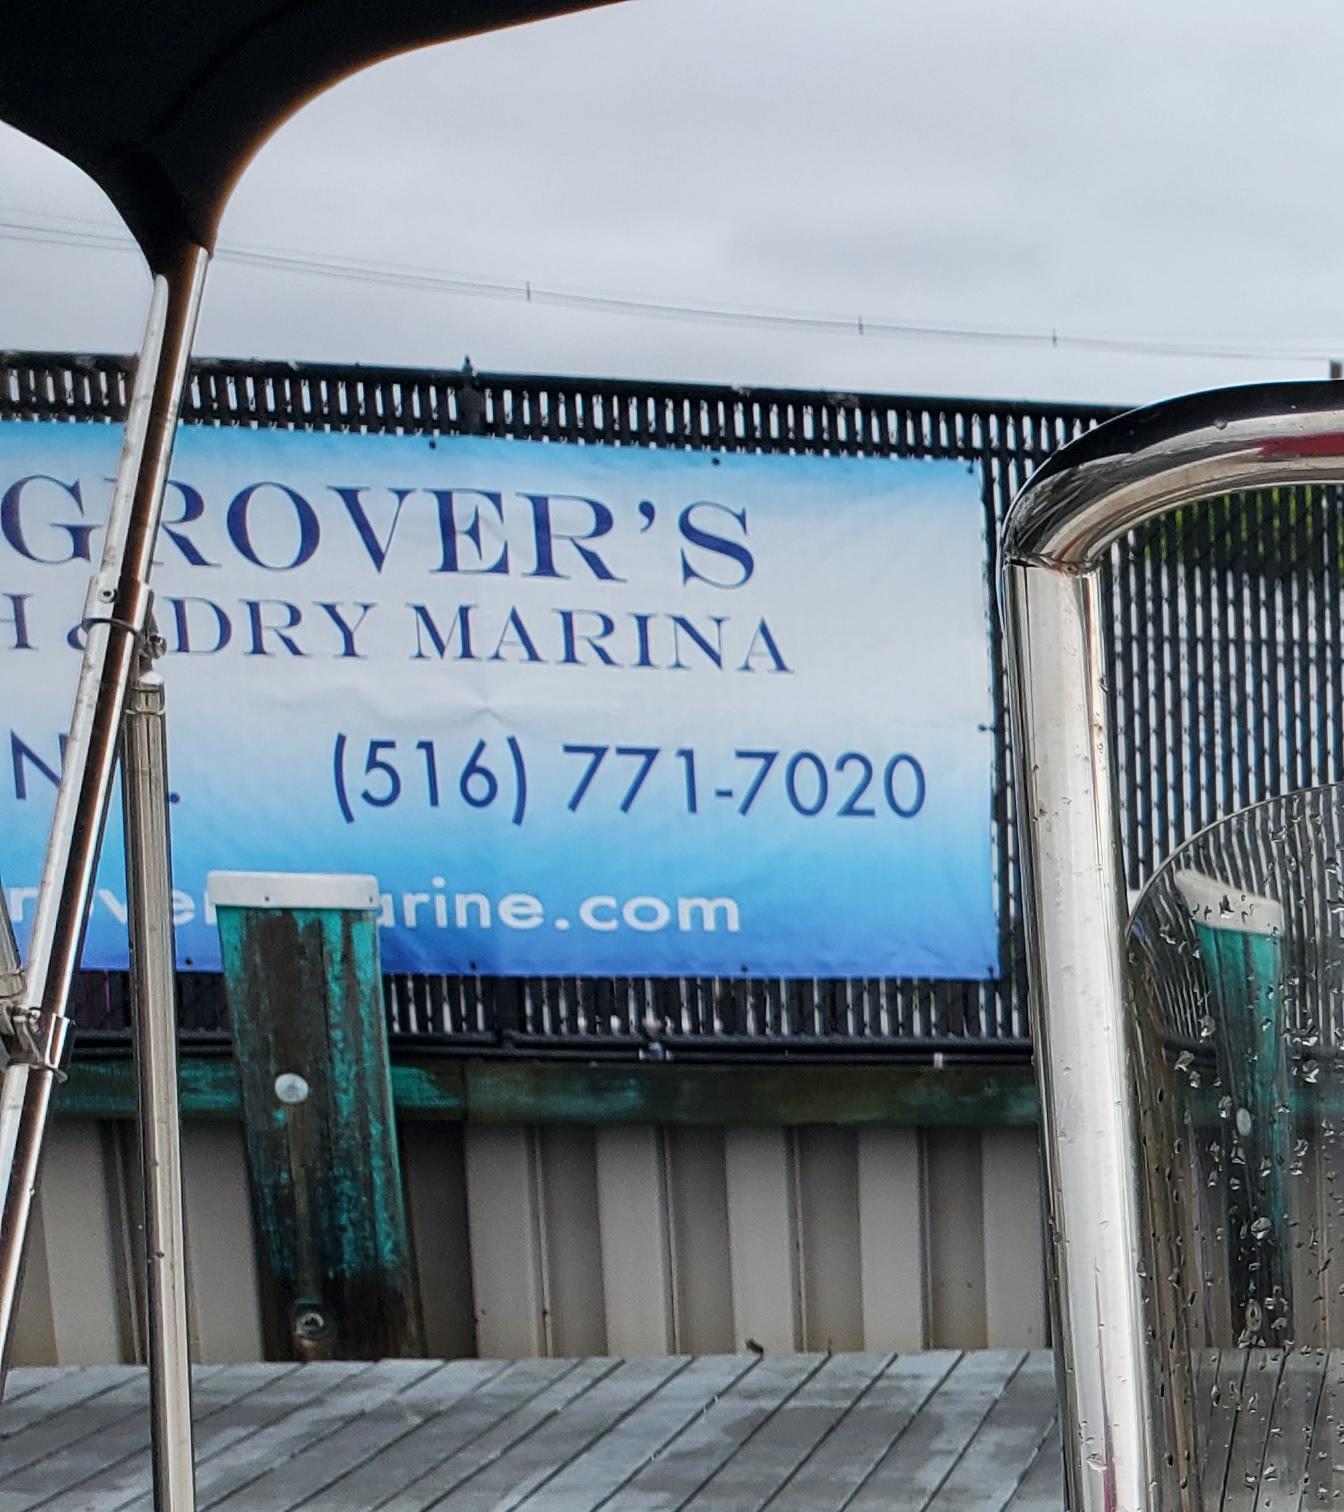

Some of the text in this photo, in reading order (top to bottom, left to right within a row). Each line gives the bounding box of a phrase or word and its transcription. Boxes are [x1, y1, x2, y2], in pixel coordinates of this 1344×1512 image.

[0, 473, 756, 591] GROVER'S
[162, 596, 378, 658] DRY
[404, 602, 795, 674] MARINA
[332, 732, 528, 825] (516)
[561, 742, 926, 820] 771-7020
